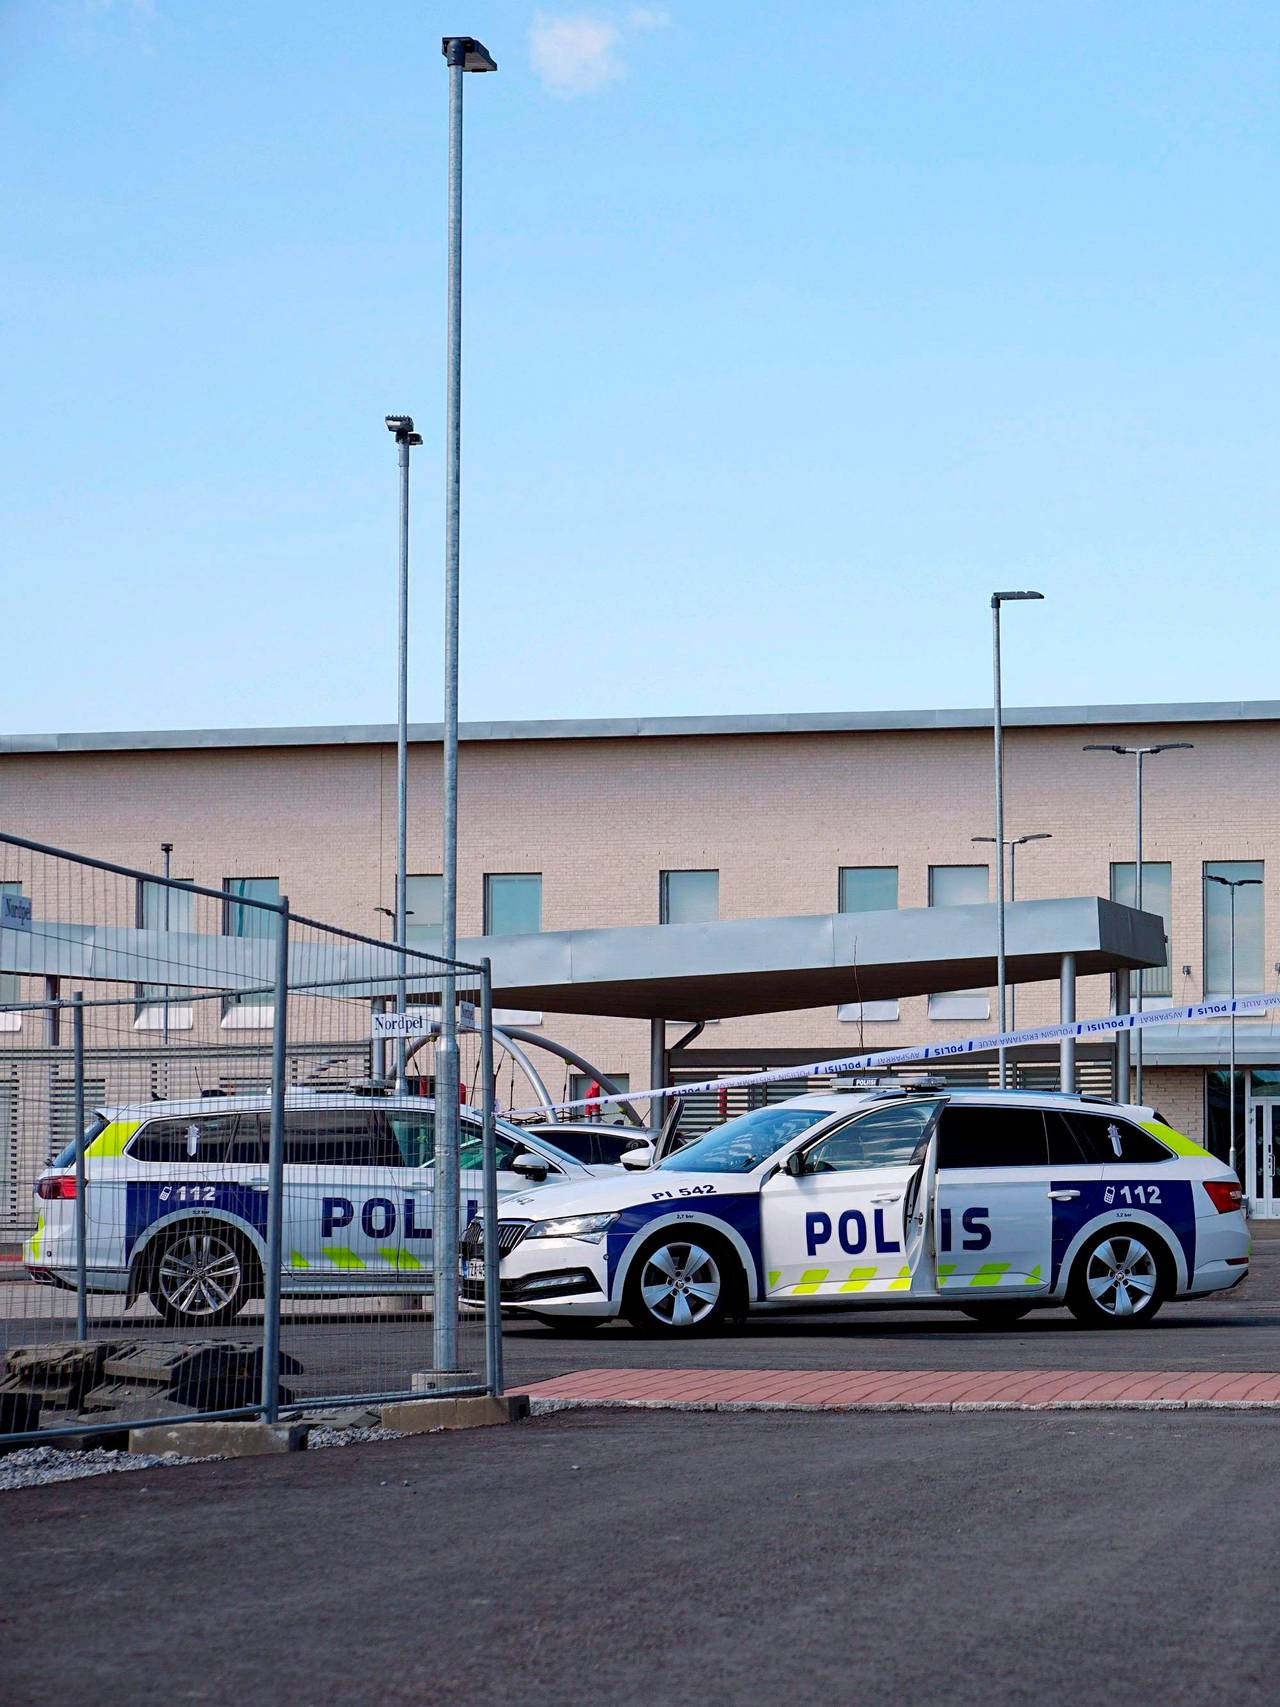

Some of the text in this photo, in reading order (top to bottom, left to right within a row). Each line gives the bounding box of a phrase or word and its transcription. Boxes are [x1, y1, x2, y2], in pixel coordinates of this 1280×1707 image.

[1139, 1010, 1183, 1024] AVSPARRAT
[1197, 1004, 1226, 1016] POLIS
[375, 1015, 423, 1034] Nordpel
[1086, 1019, 1123, 1032] POLIISI
[999, 1032, 1038, 1045] ERISTAMA
[1040, 1027, 1073, 1039] POLIISIN
[933, 1044, 963, 1056] POLIS
[823, 1060, 861, 1074] POLIISI
[855, 1078, 877, 1087] POLIISI
[176, 1185, 216, 1201] 112
[651, 1184, 717, 1200] PI 542
[1120, 1185, 1162, 1204] 112
[805, 1207, 992, 1256] POLIS
